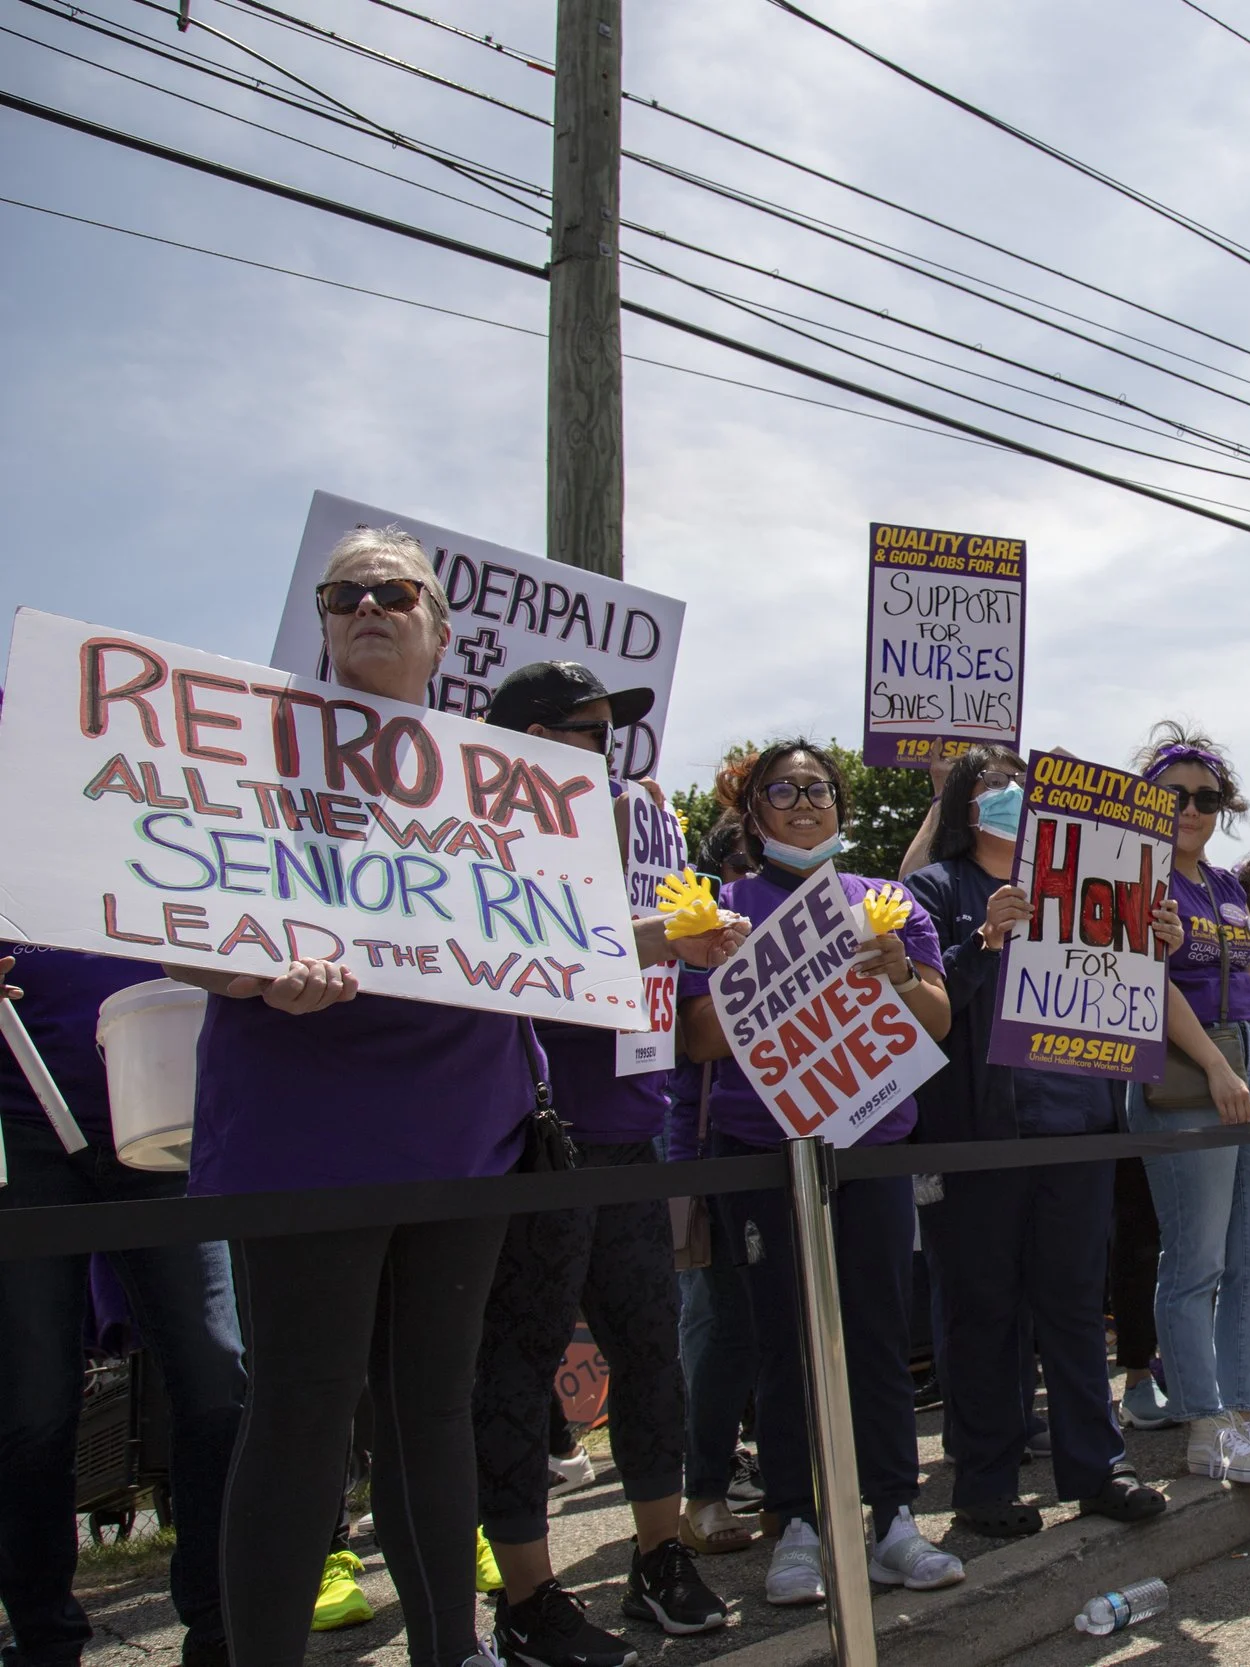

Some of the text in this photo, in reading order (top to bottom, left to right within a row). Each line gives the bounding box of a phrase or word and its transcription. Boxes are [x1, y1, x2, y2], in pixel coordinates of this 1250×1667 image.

[875, 526, 1022, 560] QUALITY CARE
[875, 549, 1020, 576] & GOOD JOBS FOR ALL
[432, 546, 662, 662] DERPAID
[884, 572, 1020, 623] SUPPORT
[882, 638, 1013, 682] NURSES
[916, 622, 962, 644] FOR
[871, 681, 944, 718] SAVES
[80, 637, 444, 808] RETRO
[460, 743, 595, 838] PAY
[83, 753, 242, 819] ALL
[237, 779, 368, 841] THE
[1030, 785, 1173, 837] & GOOD JOBS FOR ALL
[1034, 756, 1178, 818] QUALITY CARE
[125, 810, 455, 921] SENIOR
[634, 798, 687, 872] SAFE
[102, 893, 344, 963] LEAD
[353, 938, 442, 974] THE
[720, 876, 845, 1015] SAFE
[733, 929, 859, 1047] STAFFING
[1065, 949, 1120, 982] FOR
[749, 967, 882, 1086] SAVES
[1016, 967, 1158, 1032] NURSES
[774, 1003, 917, 1137] LIVES
[1029, 1053, 1133, 1073] United Healthcare Workers East
[1030, 1032, 1136, 1063] 1199SEIU
[849, 1080, 897, 1125] 1199SEIU
